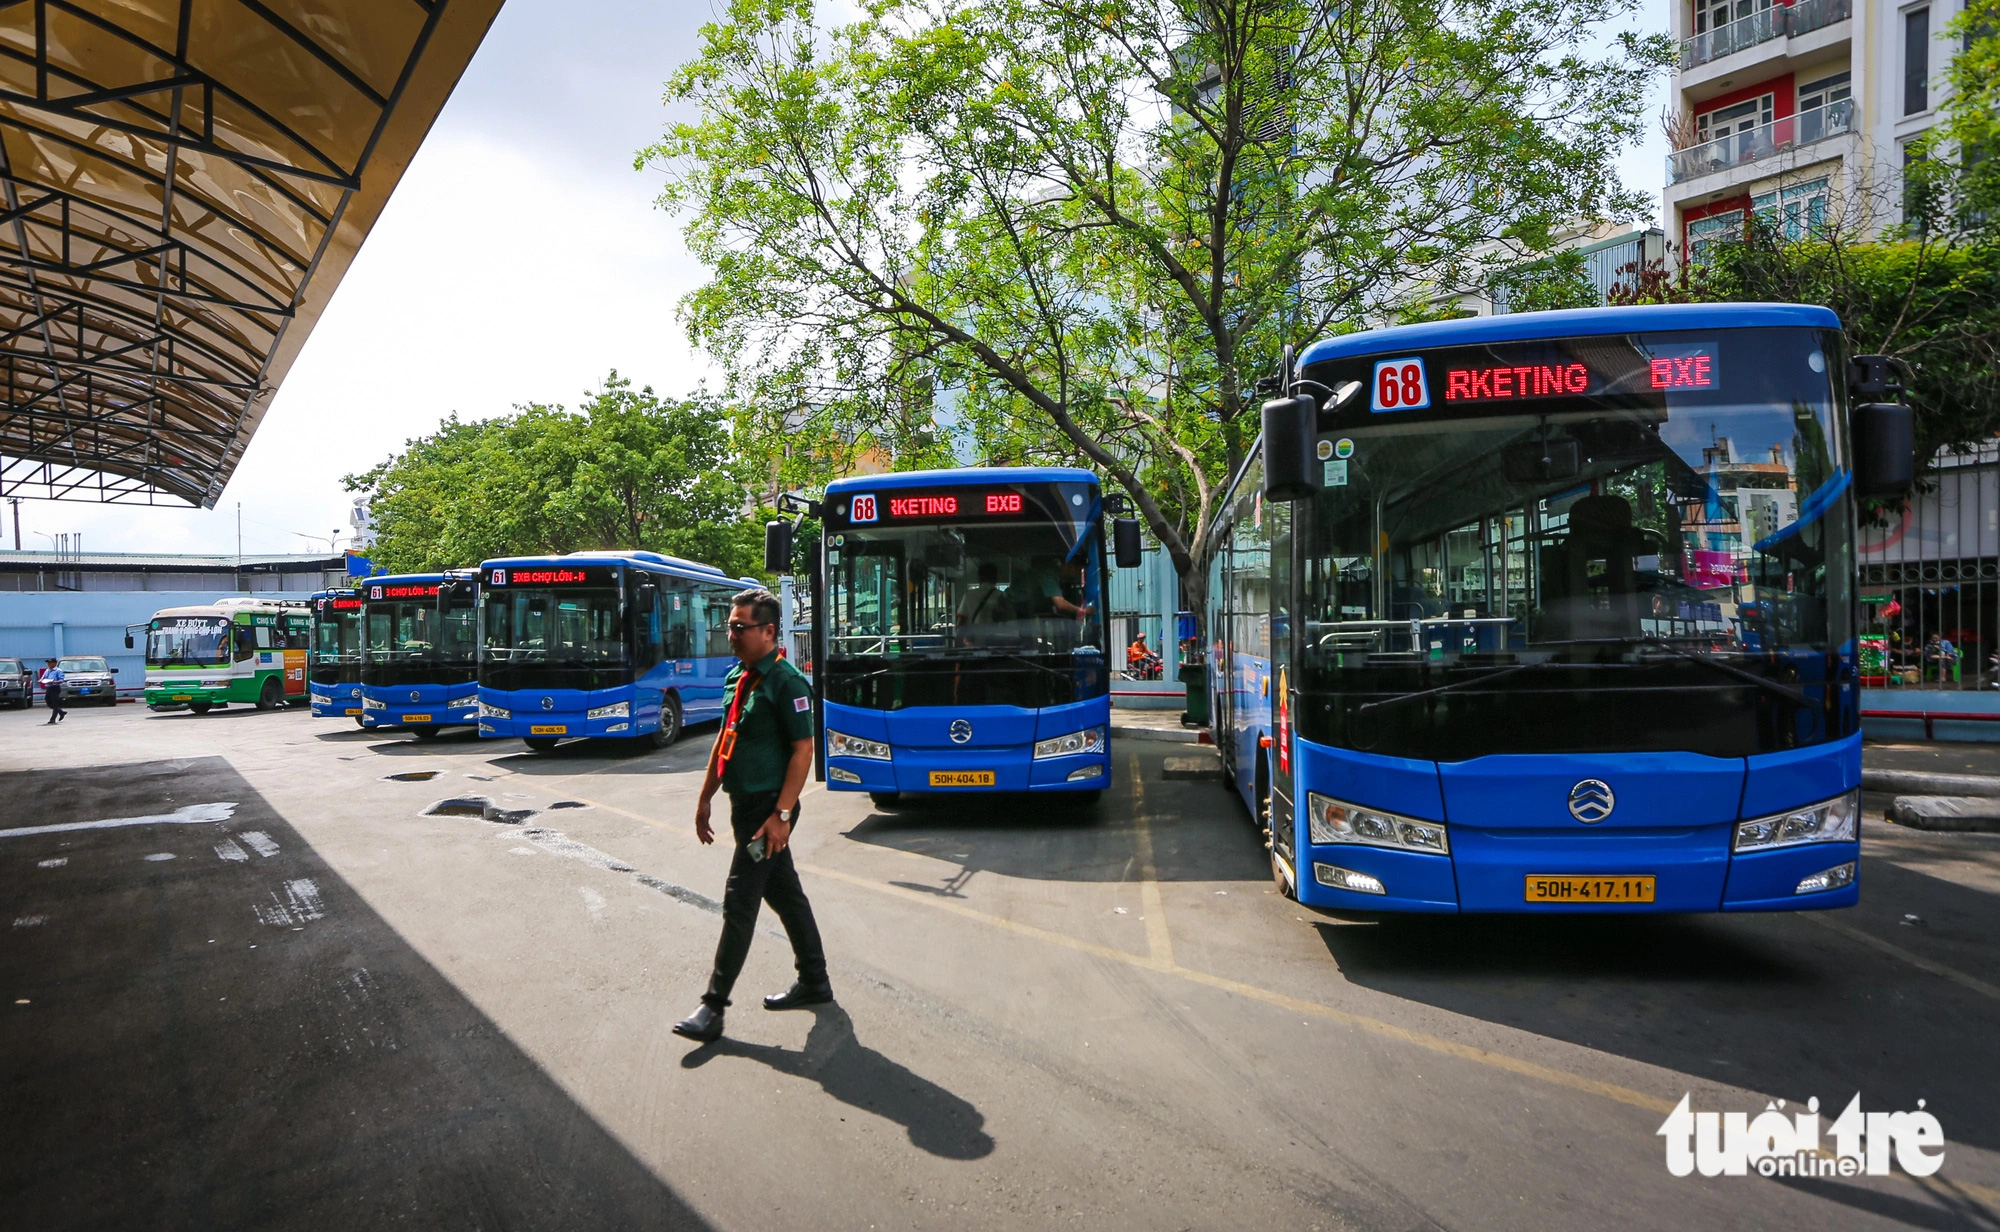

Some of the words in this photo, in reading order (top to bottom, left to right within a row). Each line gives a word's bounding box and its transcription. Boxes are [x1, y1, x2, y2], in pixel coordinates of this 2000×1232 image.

[1378, 363, 1422, 408] 68
[1445, 363, 1588, 400] RKETING
[853, 497, 875, 521] 68
[986, 494, 1022, 513] BXB
[493, 571, 504, 584] 61
[372, 588, 381, 598] 61
[175, 619, 187, 628] XE
[934, 773, 990, 784] 50H-404.18
[1536, 881, 1642, 898] 50H-417.11
